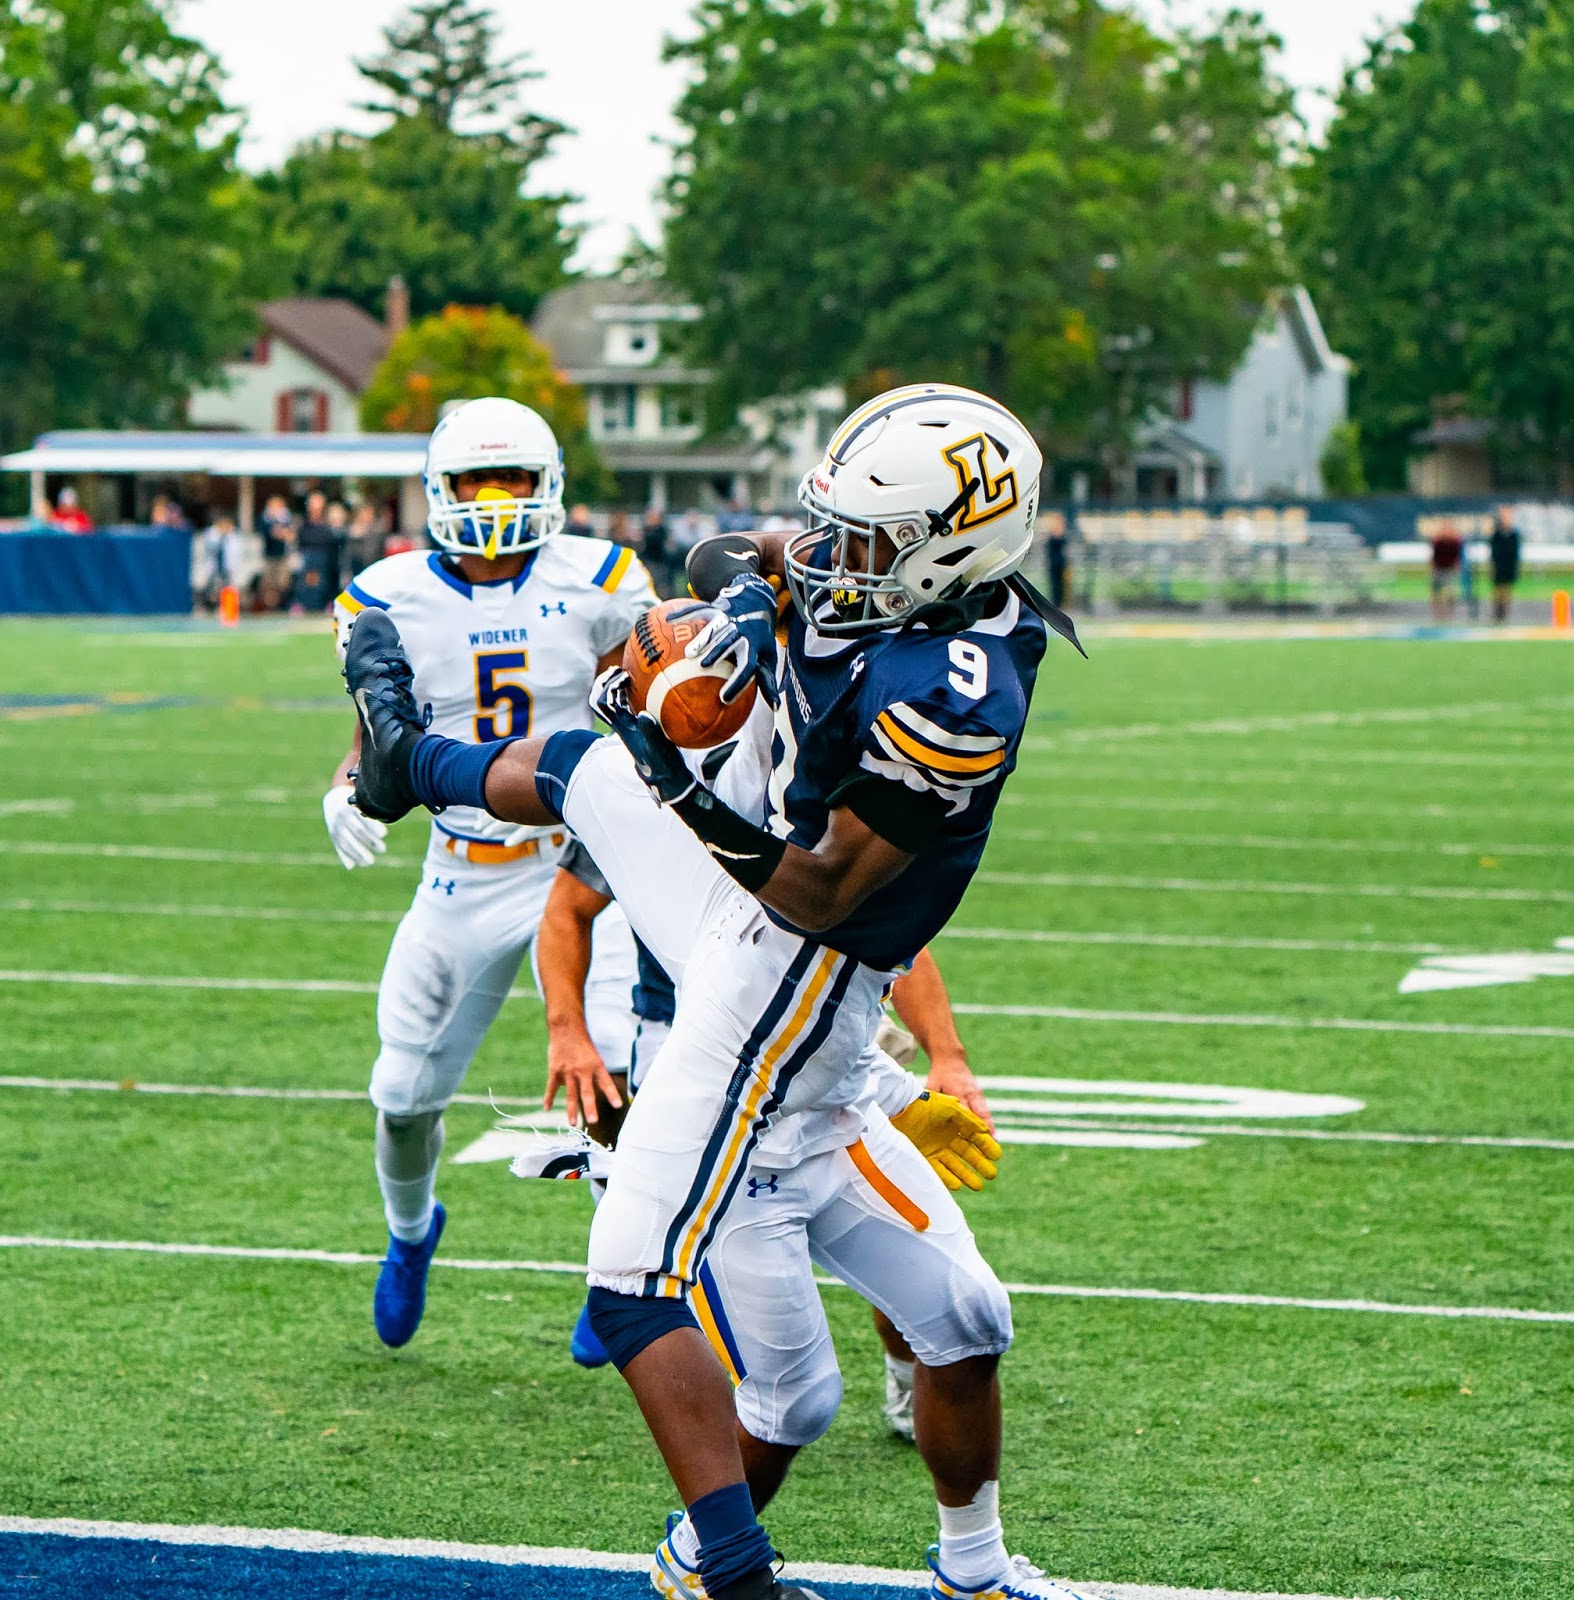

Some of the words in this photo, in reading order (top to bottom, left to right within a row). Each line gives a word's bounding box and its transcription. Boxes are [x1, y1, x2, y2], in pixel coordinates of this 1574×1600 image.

[940, 431, 1019, 536] L
[468, 628, 528, 646] WIDENER
[947, 638, 988, 701] 9
[472, 649, 534, 743] 5
